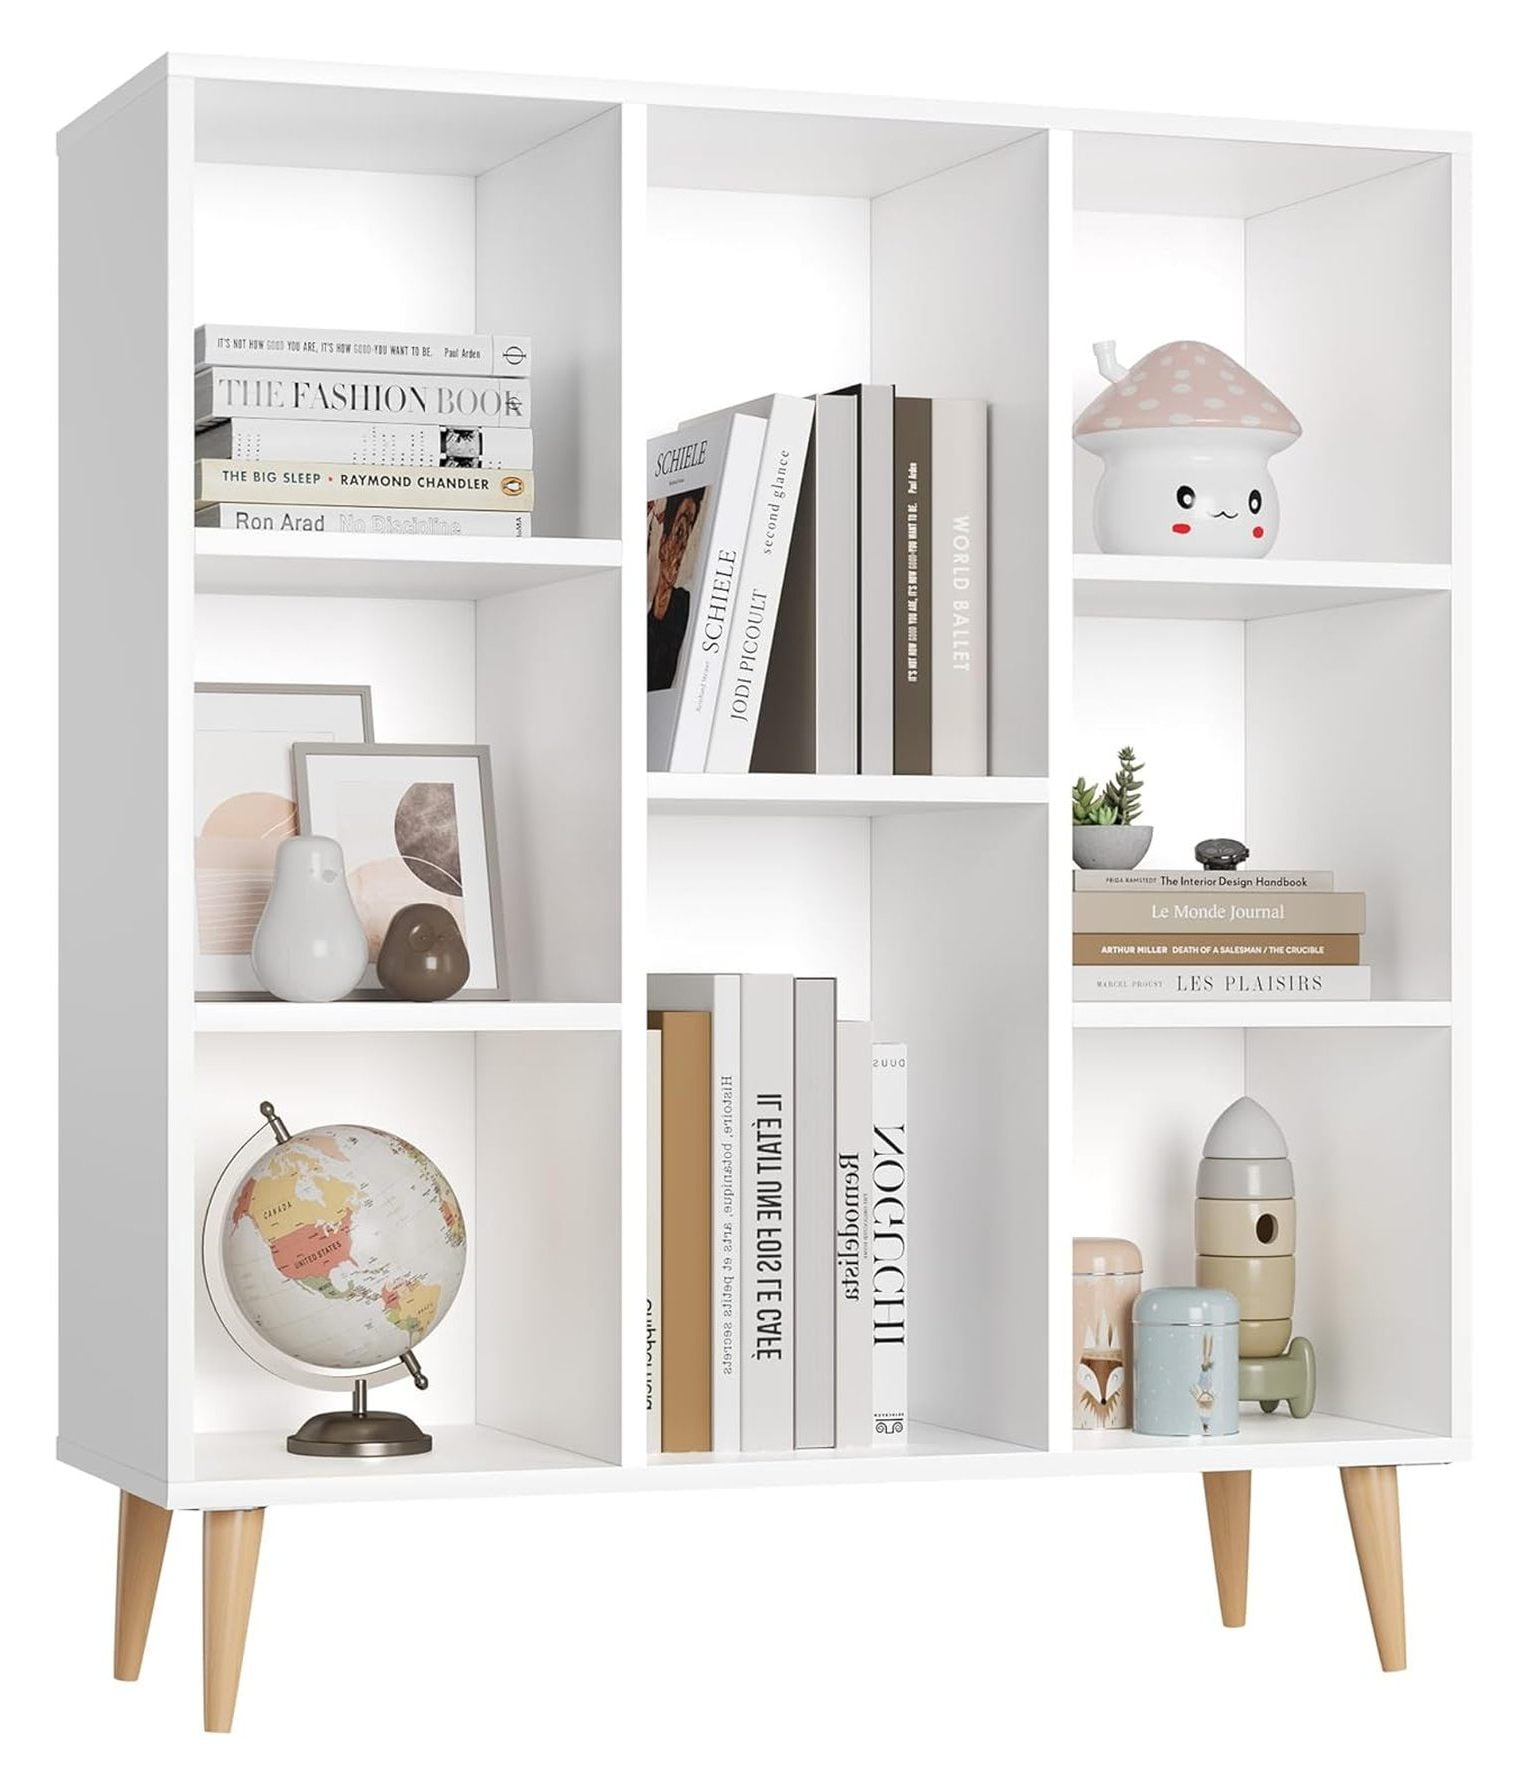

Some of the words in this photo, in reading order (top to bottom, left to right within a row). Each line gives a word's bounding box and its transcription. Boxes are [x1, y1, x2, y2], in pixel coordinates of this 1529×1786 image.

[218, 338, 231, 348] IT'S
[233, 339, 246, 349] NOT
[249, 340, 264, 350] HOW
[287, 341, 300, 352] YOU
[321, 343, 334, 353] IT'S
[337, 343, 352, 353] HOW
[390, 345, 409, 356] WANT
[411, 346, 420, 356] TO
[444, 348, 459, 358] Paul
[461, 349, 481, 359] Arden
[219, 379, 285, 408] THE
[294, 381, 428, 413] FASHION
[437, 387, 523, 417] BOOK
[655, 440, 708, 477] SCHIELE
[222, 471, 247, 482] THE
[253, 472, 277, 483] BIG
[284, 472, 321, 485] SLEEP
[341, 474, 412, 488] RAYMOND
[417, 477, 490, 491] CHANDLER
[771, 450, 790, 499] glance
[236, 511, 273, 531] Ron
[281, 512, 325, 532] Arad
[339, 513, 367, 534] No
[764, 503, 780, 555] second
[952, 515, 970, 590] WORLD
[702, 549, 737, 654] SCHIELE
[740, 588, 767, 671] PICOULT
[952, 600, 970, 672] BALLET
[731, 678, 752, 722] JODI
[1160, 876, 1179, 887] The
[1180, 876, 1218, 887] Interior
[1219, 876, 1253, 889] Design
[1256, 876, 1308, 887] Handbook
[1151, 904, 1170, 919] Le
[1174, 904, 1226, 919] Monde
[1230, 904, 1285, 921] Journal
[1100, 945, 1136, 954] ARTHUR
[1137, 945, 1168, 954] MILLER
[1172, 945, 1199, 954] DEATH
[1200, 946, 1211, 954] OF
[1212, 946, 1219, 954] A
[1220, 946, 1262, 954] SALESMAN
[1269, 946, 1285, 954] THE
[1286, 946, 1324, 954] CRUCIBLE
[1177, 975, 1214, 992] LES
[1225, 975, 1323, 992] PLAISIRS
[263, 1201, 292, 1220] CANADA
[294, 1251, 318, 1269] UNITED
[316, 1240, 342, 1259] STATES
